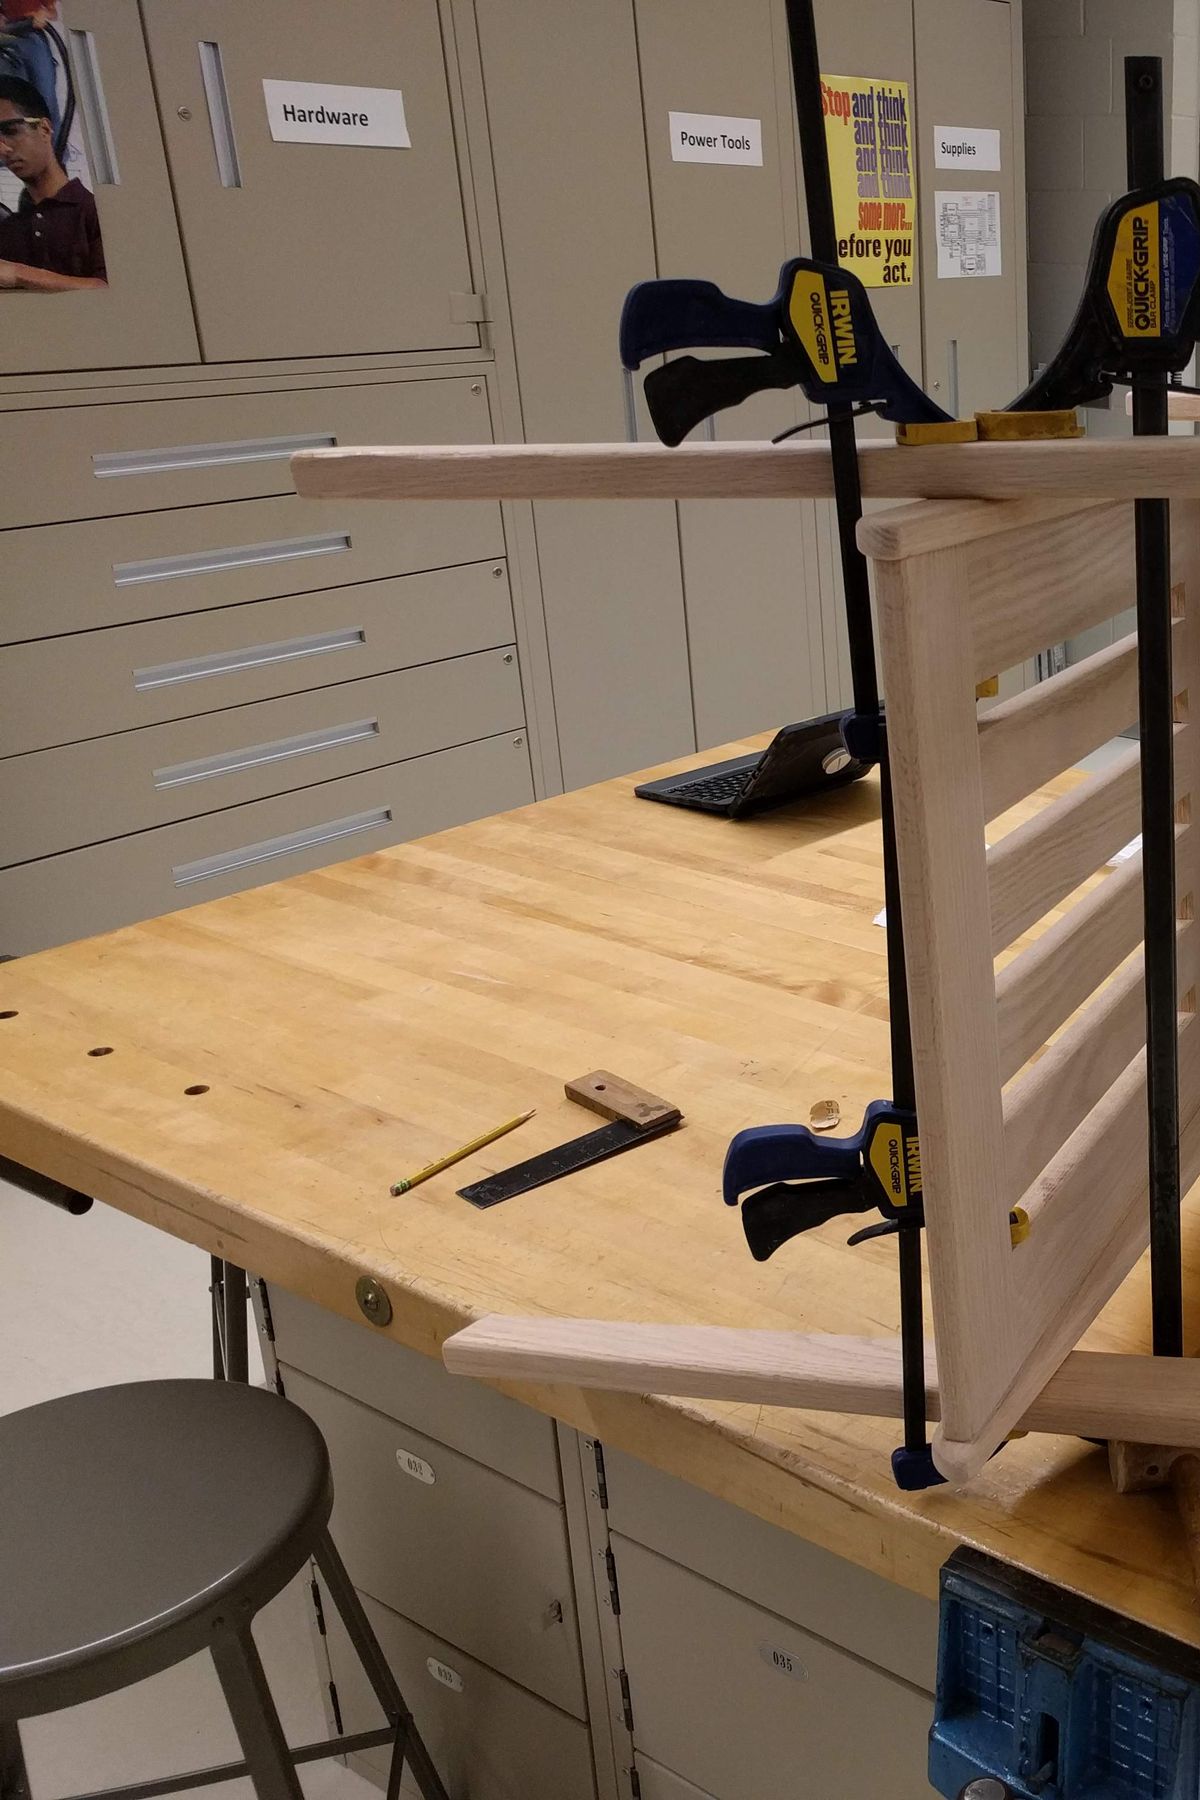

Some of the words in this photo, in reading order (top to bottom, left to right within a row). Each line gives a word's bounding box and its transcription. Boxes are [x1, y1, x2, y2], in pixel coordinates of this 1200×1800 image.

[282, 103, 369, 127] Hardware
[820, 81, 851, 126] Stop
[852, 86, 875, 118] and
[876, 87, 907, 122] think
[680, 131, 718, 148] Power
[719, 134, 751, 151] Tools
[854, 119, 877, 145] and
[878, 120, 909, 148] think
[856, 146, 878, 172] and
[880, 147, 910, 174] think
[940, 141, 977, 157] Supplies
[858, 202, 882, 230] some
[884, 238, 912, 264] you
[882, 262, 911, 284] act.
[1132, 216, 1151, 331] QUICK-GRIP
[1149, 280, 1157, 310] CLAMP
[810, 292, 829, 366] QUICK-GRIP
[830, 290, 858, 364] IRWIN
[888, 1139, 901, 1194] QUICK-GRIP
[906, 1136, 922, 1193] IRWIN
[773, 1651, 793, 1672] 035
